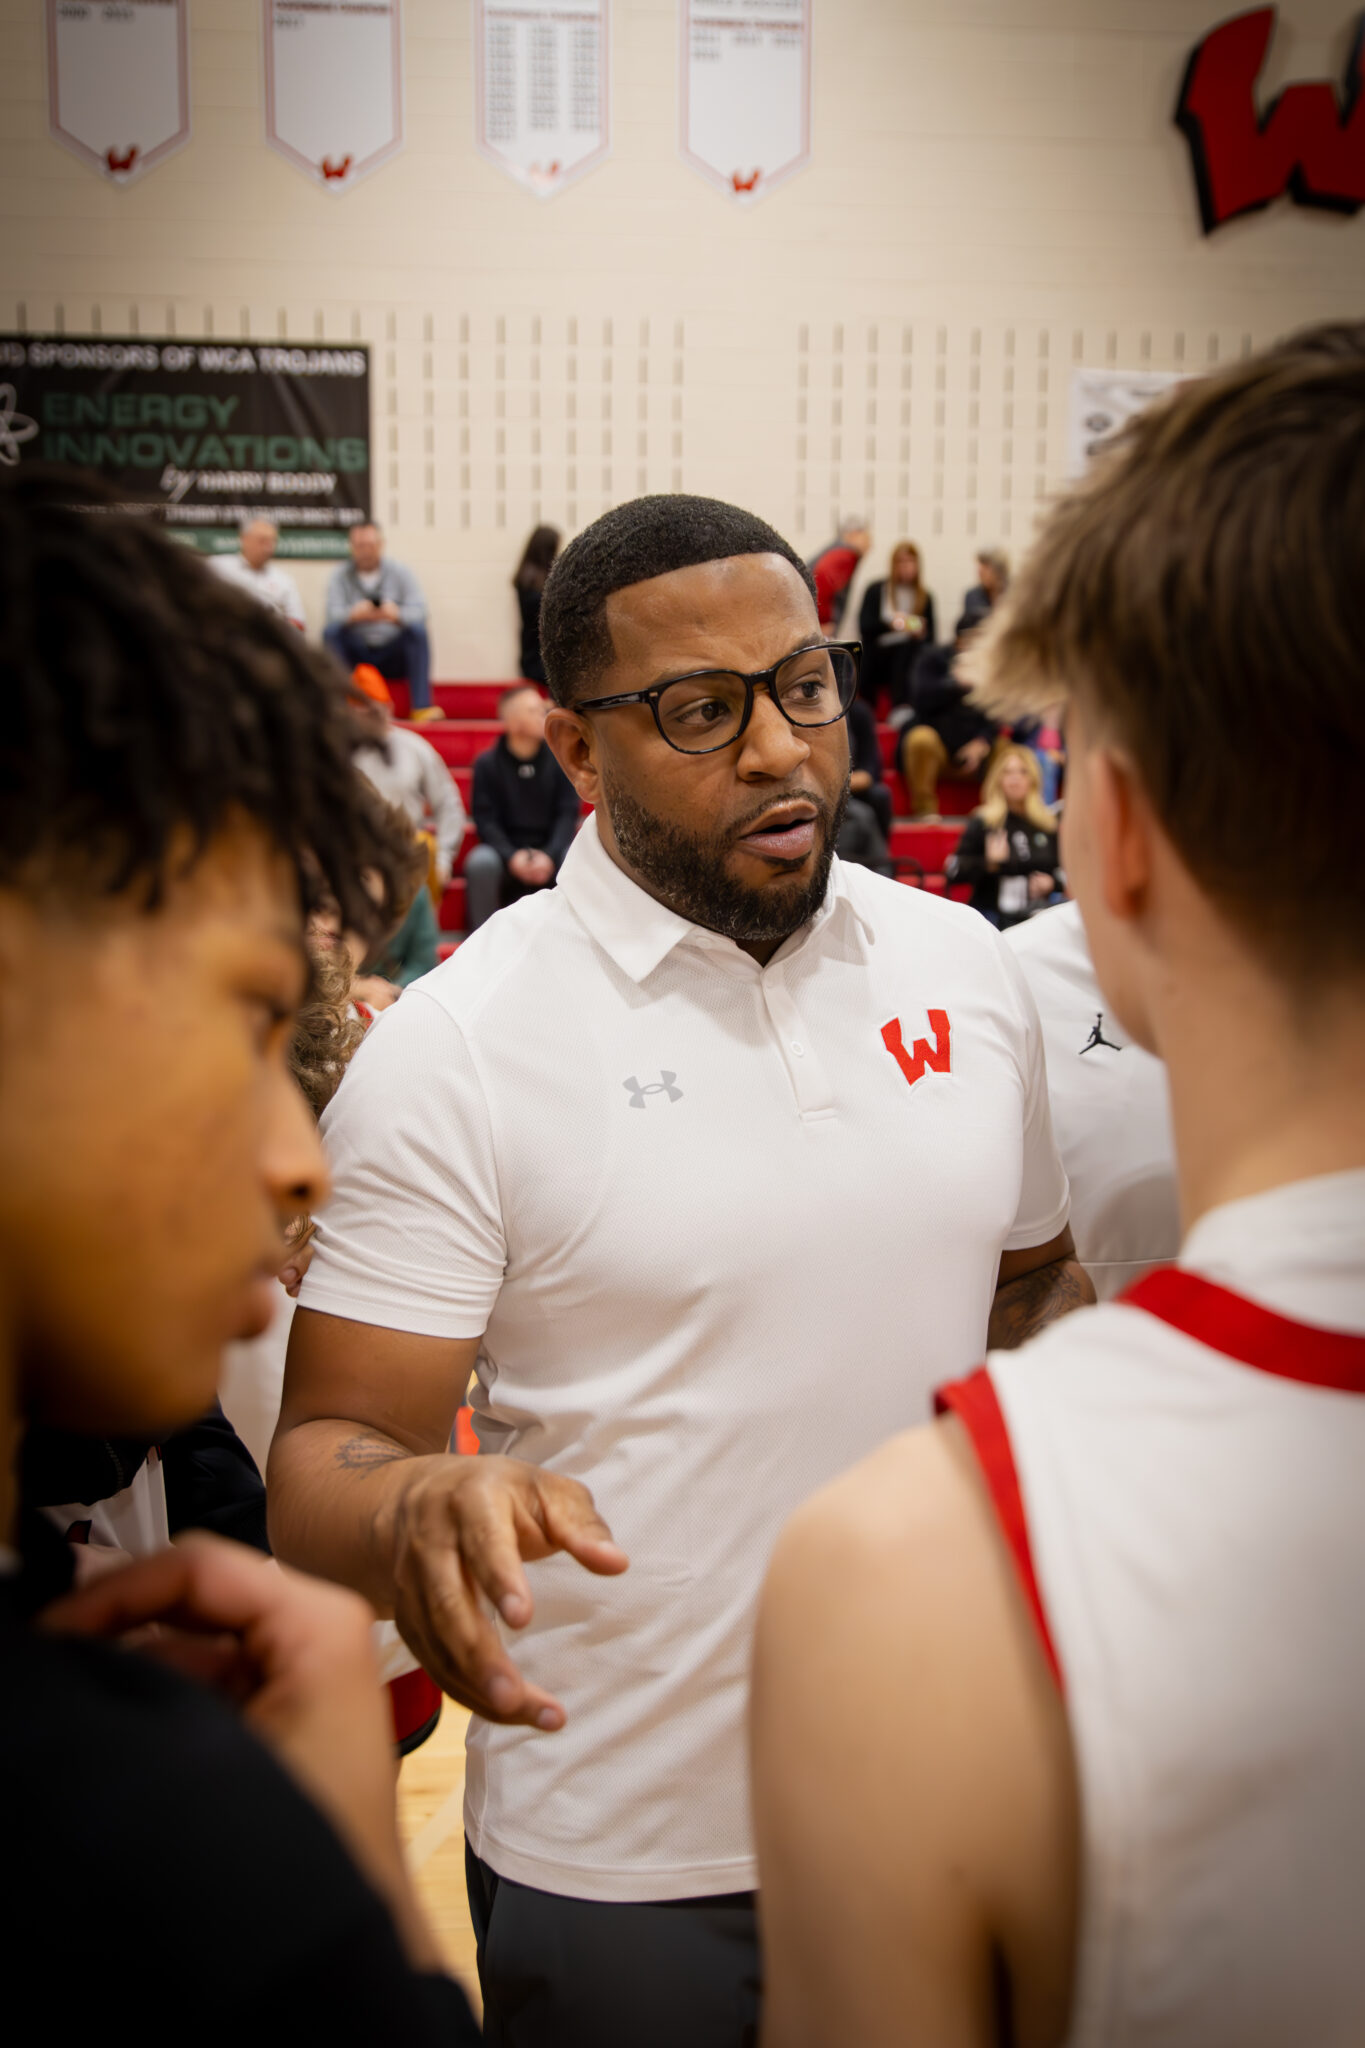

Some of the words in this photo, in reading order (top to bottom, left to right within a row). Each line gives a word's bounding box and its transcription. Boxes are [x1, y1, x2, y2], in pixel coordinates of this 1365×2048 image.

[1174, 4, 1365, 236] W
[28, 342, 159, 371] SPONSORS
[161, 345, 195, 371] OF
[198, 346, 256, 373] WCA
[256, 347, 366, 377] TROJANS
[43, 393, 239, 429] ENERGY
[43, 432, 367, 472] INNOVATIONS
[880, 1008, 951, 1087] W
